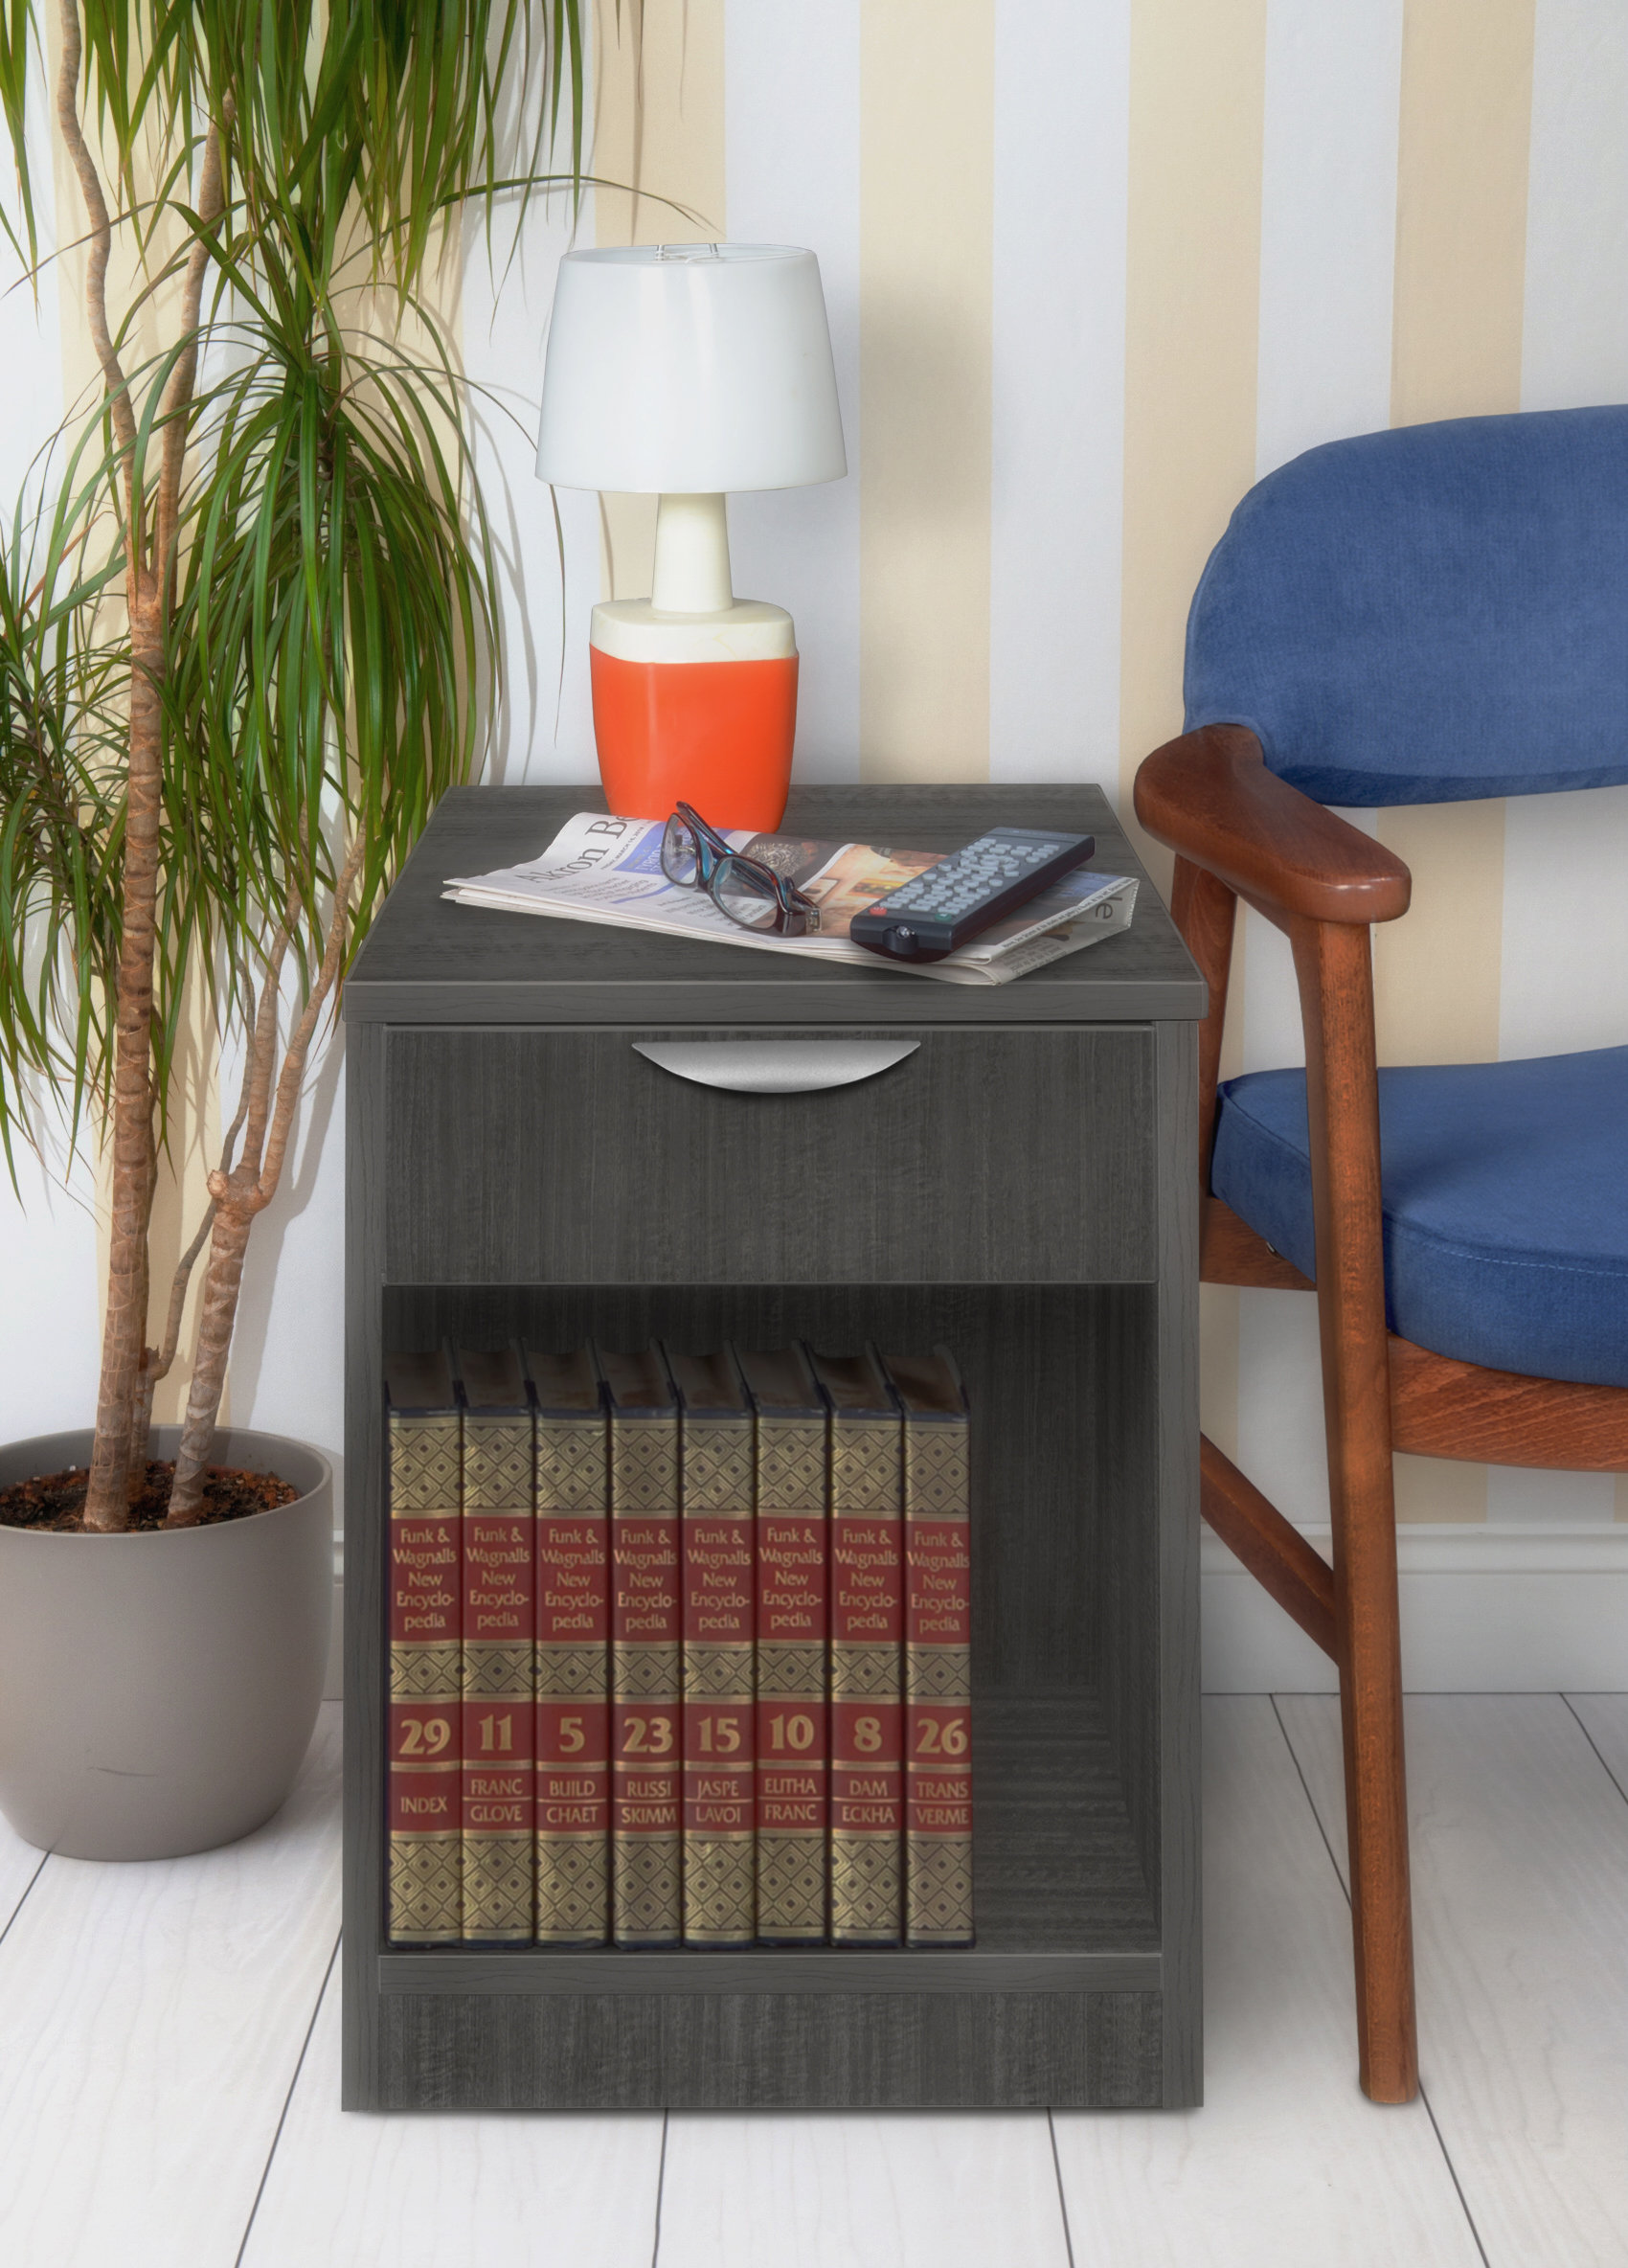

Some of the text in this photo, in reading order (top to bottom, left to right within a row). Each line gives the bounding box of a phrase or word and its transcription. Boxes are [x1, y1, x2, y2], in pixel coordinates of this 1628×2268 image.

[514, 849, 609, 883] Akron
[401, 1528, 449, 1543] Funk &
[475, 1527, 523, 1542] Funk &
[550, 1529, 598, 1544] Funk &
[622, 1529, 670, 1544] Funk &
[695, 1529, 744, 1544] Funk &
[768, 1528, 816, 1543] Funk &
[844, 1529, 892, 1544] Funk &
[915, 1531, 963, 1547] Funk &
[393, 1548, 456, 1568] Wagnalls
[465, 1548, 530, 1567] Wagnalls
[542, 1550, 604, 1568] Wagnalls
[614, 1549, 677, 1569] Wagnalls
[688, 1550, 751, 1569] Wagnalls
[759, 1548, 823, 1567] Wagnalls
[834, 1548, 897, 1569] Wagnalls
[907, 1551, 968, 1572] Wagnalls
[409, 1573, 442, 1586] New
[483, 1571, 515, 1585] New
[557, 1573, 590, 1586] New
[630, 1573, 663, 1587] New
[703, 1573, 736, 1586] New
[776, 1571, 808, 1585] New
[851, 1573, 884, 1586] New
[923, 1575, 957, 1590] New
[396, 1591, 454, 1610] Encyclo-
[470, 1590, 529, 1608] Encyclo-
[545, 1591, 603, 1610] Encyclo-
[618, 1591, 677, 1611] Encyclo-
[691, 1592, 750, 1611] Encyclo-
[763, 1590, 822, 1609] Encyclo-
[840, 1591, 896, 1611] Encyclo-
[911, 1593, 968, 1613] Encyclo-
[405, 1613, 445, 1632] pedia
[478, 1612, 518, 1630] pedia
[553, 1614, 593, 1631] pedia
[626, 1615, 667, 1632] pedia
[699, 1615, 739, 1631] pedia
[771, 1612, 811, 1629] pedia
[848, 1614, 888, 1630] pedia
[919, 1617, 960, 1633] pedia
[399, 1719, 450, 1754] 29
[480, 1714, 511, 1750] 11
[560, 1717, 584, 1752] 5
[622, 1717, 672, 1753] 23
[699, 1718, 740, 1752] 15
[771, 1715, 814, 1749] 10
[854, 1717, 882, 1752] 8
[916, 1719, 966, 1755] 26
[471, 1779, 522, 1794] FRANC
[550, 1780, 596, 1796] BUILD
[628, 1780, 670, 1797] RUSSI
[697, 1780, 738, 1801] JASPE
[850, 1780, 887, 1796] DAM
[916, 1781, 967, 1798] TRANS
[401, 1797, 446, 1813] INDEX
[470, 1805, 522, 1822] GLOVE
[766, 1804, 817, 1820] FRANC
[547, 1806, 598, 1823] CHAET
[622, 1807, 674, 1824] SKIMM
[696, 1806, 740, 1823] LAVOI
[843, 1805, 894, 1823] ECKHA
[916, 1808, 967, 1825] VERME
